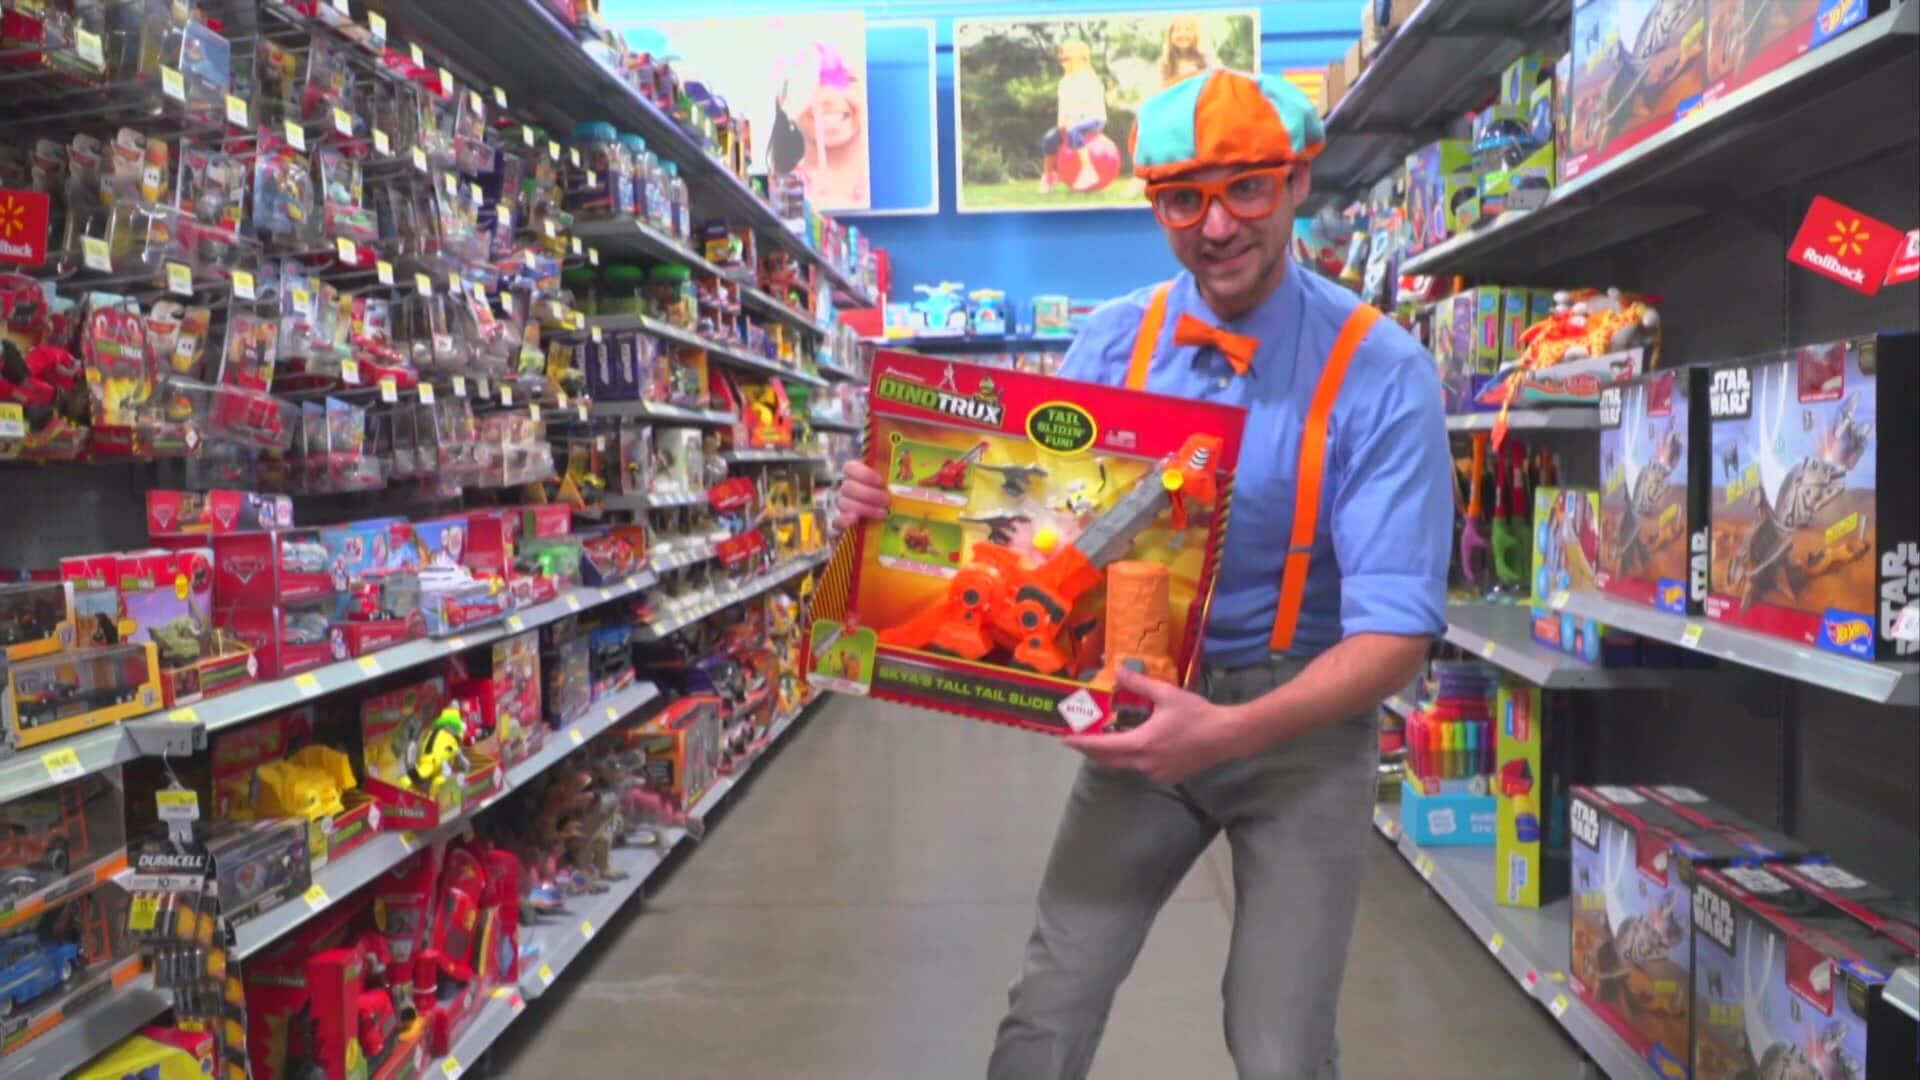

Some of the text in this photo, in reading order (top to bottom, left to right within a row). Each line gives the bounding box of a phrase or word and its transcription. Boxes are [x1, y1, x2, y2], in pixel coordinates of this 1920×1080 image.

[1802, 246, 1864, 285] Rollback
[1710, 368, 1750, 393] STAR
[879, 377, 1001, 425] DINOTRUX
[1710, 391, 1750, 416] WARS
[1048, 408, 1081, 426] TAIL
[936, 677, 971, 696] TALL
[975, 685, 1004, 702] TAIL
[1009, 692, 1053, 713] SLIDE
[138, 854, 205, 867] DURACELL
